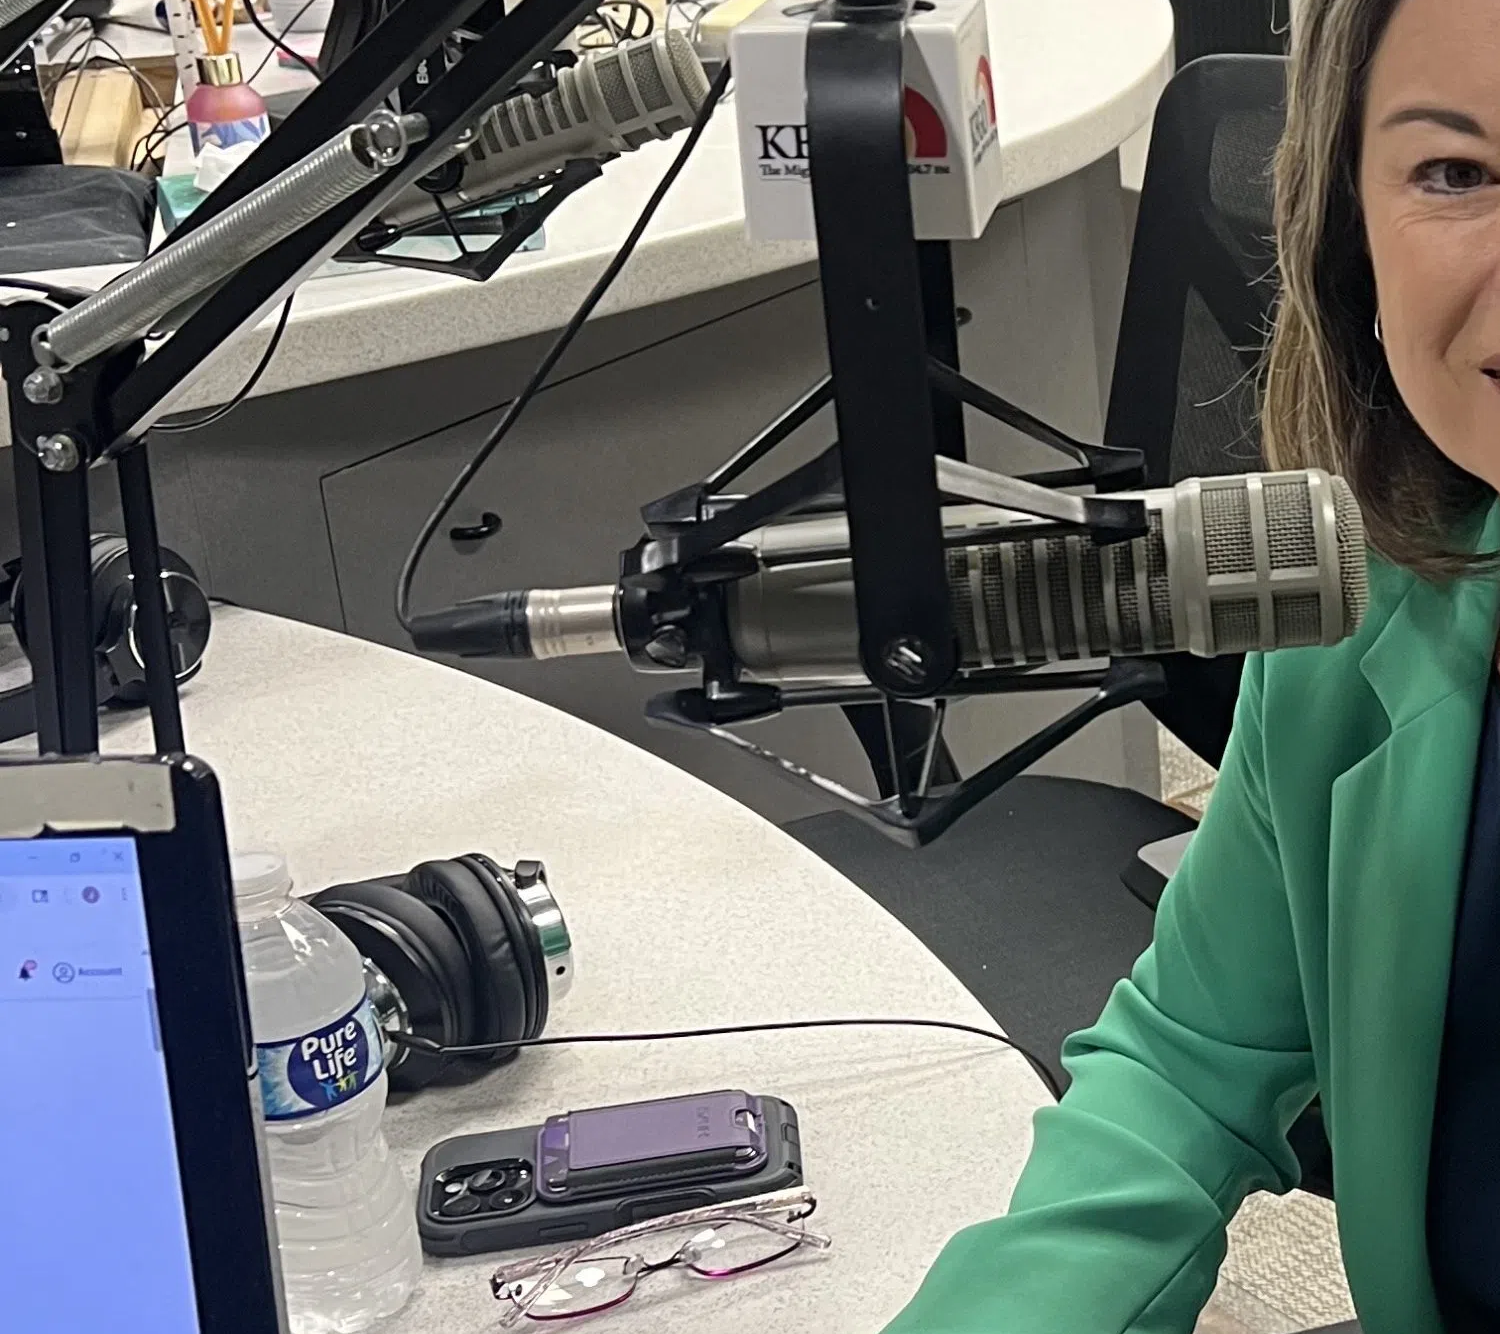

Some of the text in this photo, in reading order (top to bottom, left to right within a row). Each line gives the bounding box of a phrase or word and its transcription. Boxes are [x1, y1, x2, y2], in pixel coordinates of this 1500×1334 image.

[755, 124, 809, 160] KF
[301, 1019, 357, 1063] Pure
[312, 1047, 359, 1080] Life
